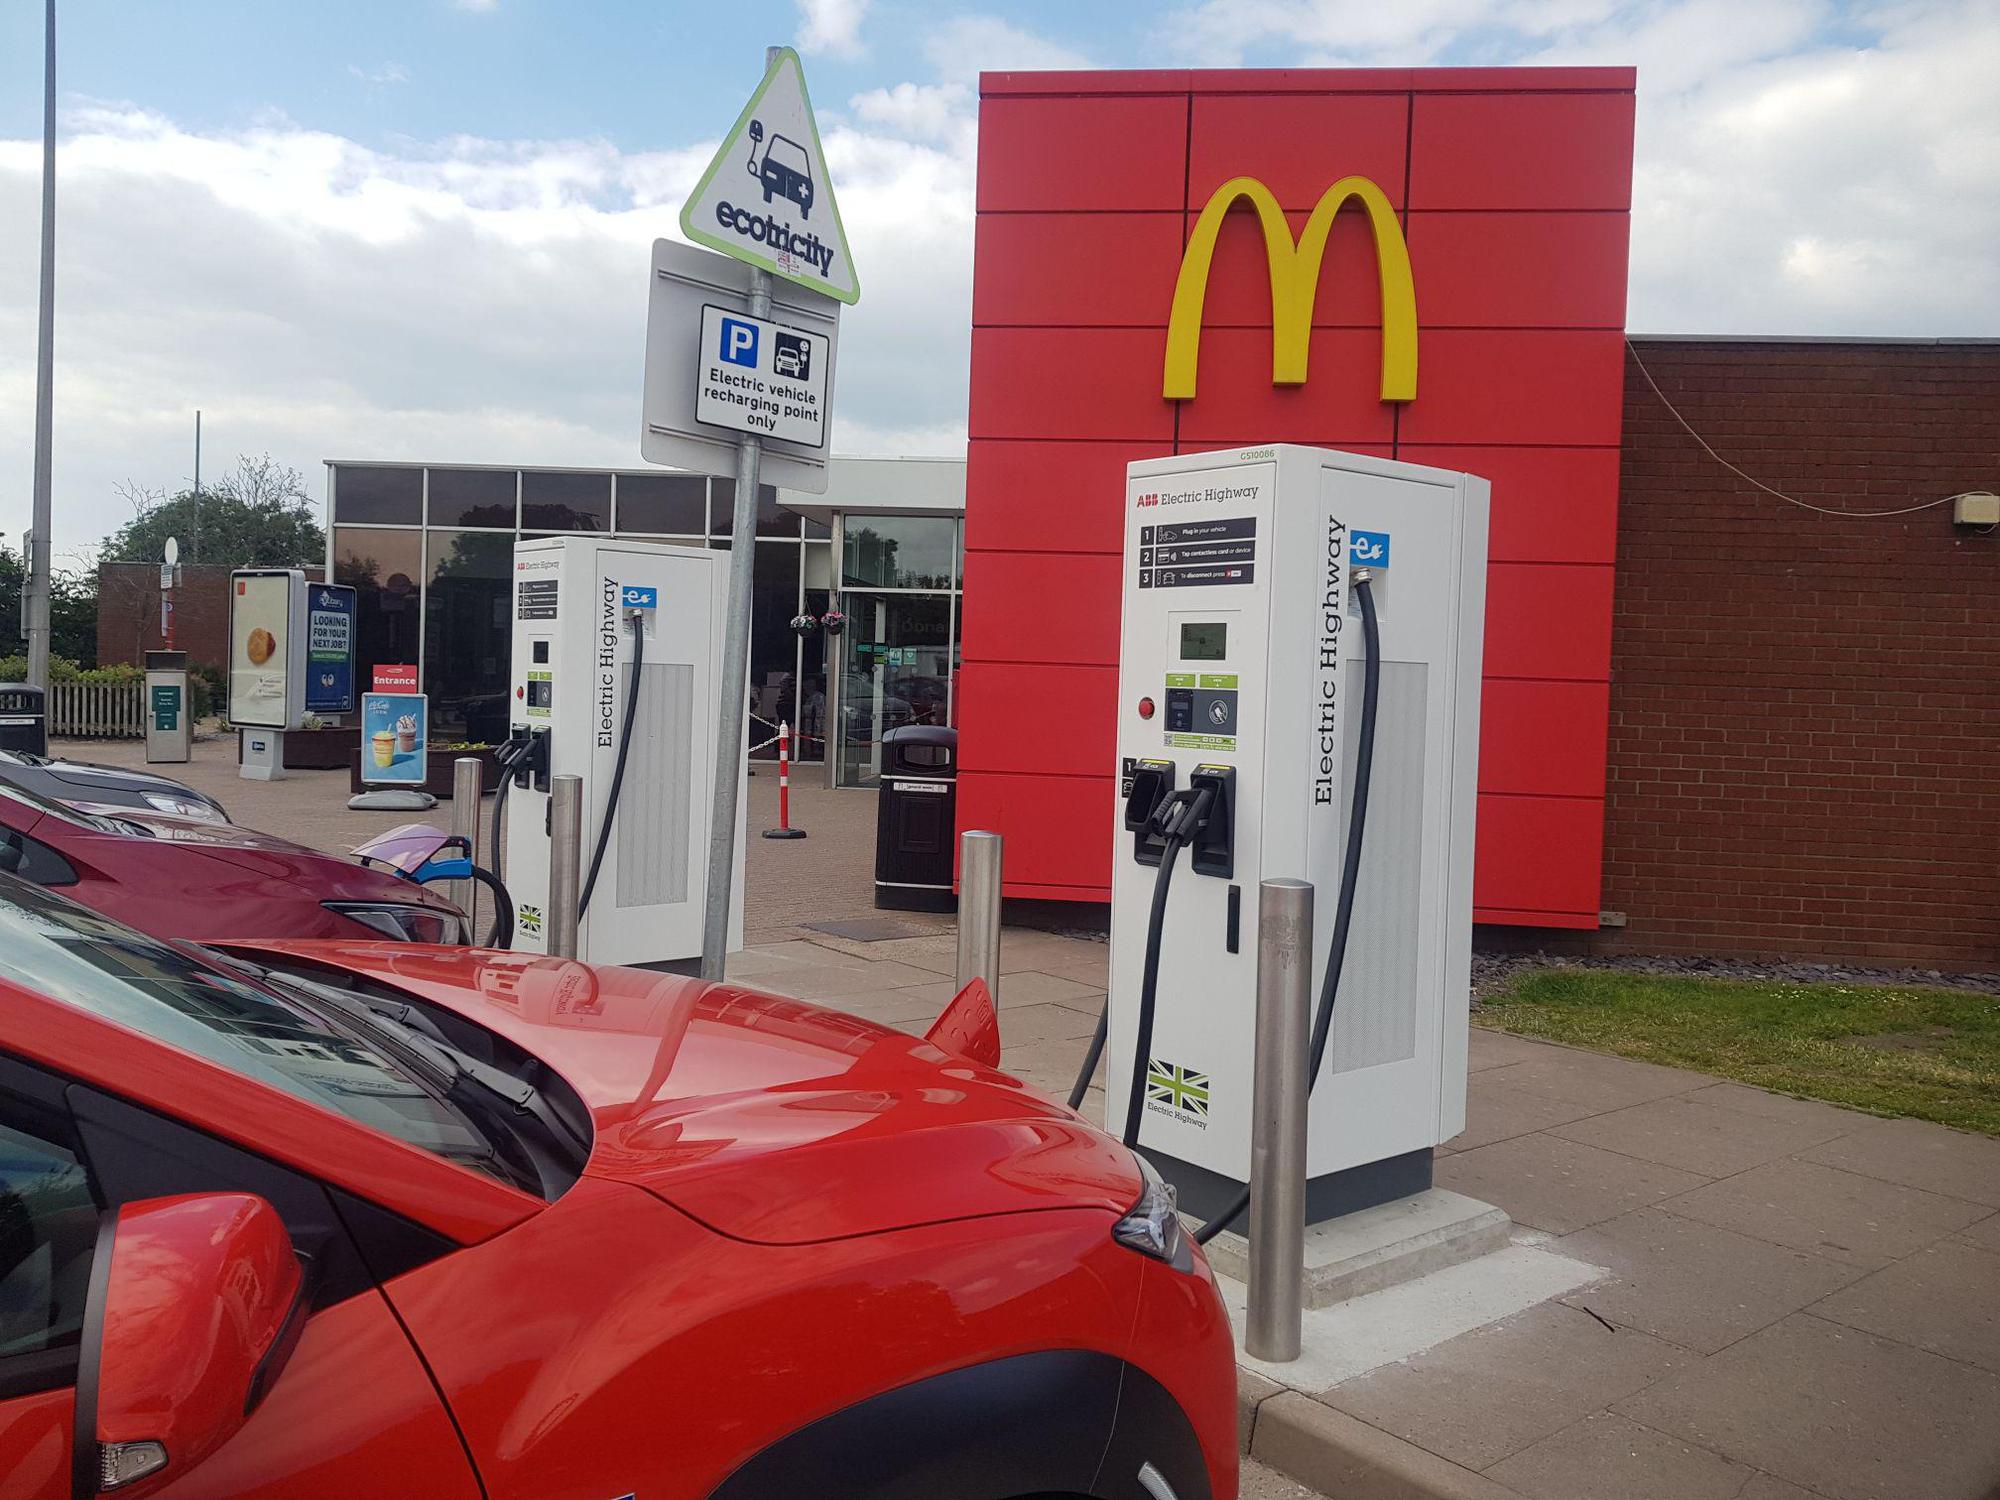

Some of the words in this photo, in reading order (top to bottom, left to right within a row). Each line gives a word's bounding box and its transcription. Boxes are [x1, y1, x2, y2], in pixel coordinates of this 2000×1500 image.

[716, 201, 834, 277] ecotricity
[729, 324, 753, 360] P
[710, 368, 764, 392] Electric
[769, 384, 816, 405] vehicle
[704, 387, 780, 415] recharging
[784, 405, 818, 422] point
[747, 414, 776, 431] only
[1137, 493, 1158, 508] ABB
[1161, 490, 1202, 505] Electric
[1204, 486, 1259, 503] Highway
[1145, 531, 1149, 540] 1
[1144, 552, 1150, 562] 2
[1143, 573, 1149, 583] 3
[1320, 514, 1346, 671] Highway
[313, 627, 327, 637] FOR
[329, 629, 347, 638] YOUR
[314, 615, 347, 627] LOOKING
[600, 576, 618, 668] Highway
[312, 639, 330, 648] NEXT
[330, 639, 347, 649] JOB?
[374, 676, 416, 685] Entrance
[598, 674, 613, 748] Electric
[1315, 680, 1336, 806] Electric
[1147, 1101, 1173, 1117] Electric
[1174, 1111, 1207, 1131] Highway
